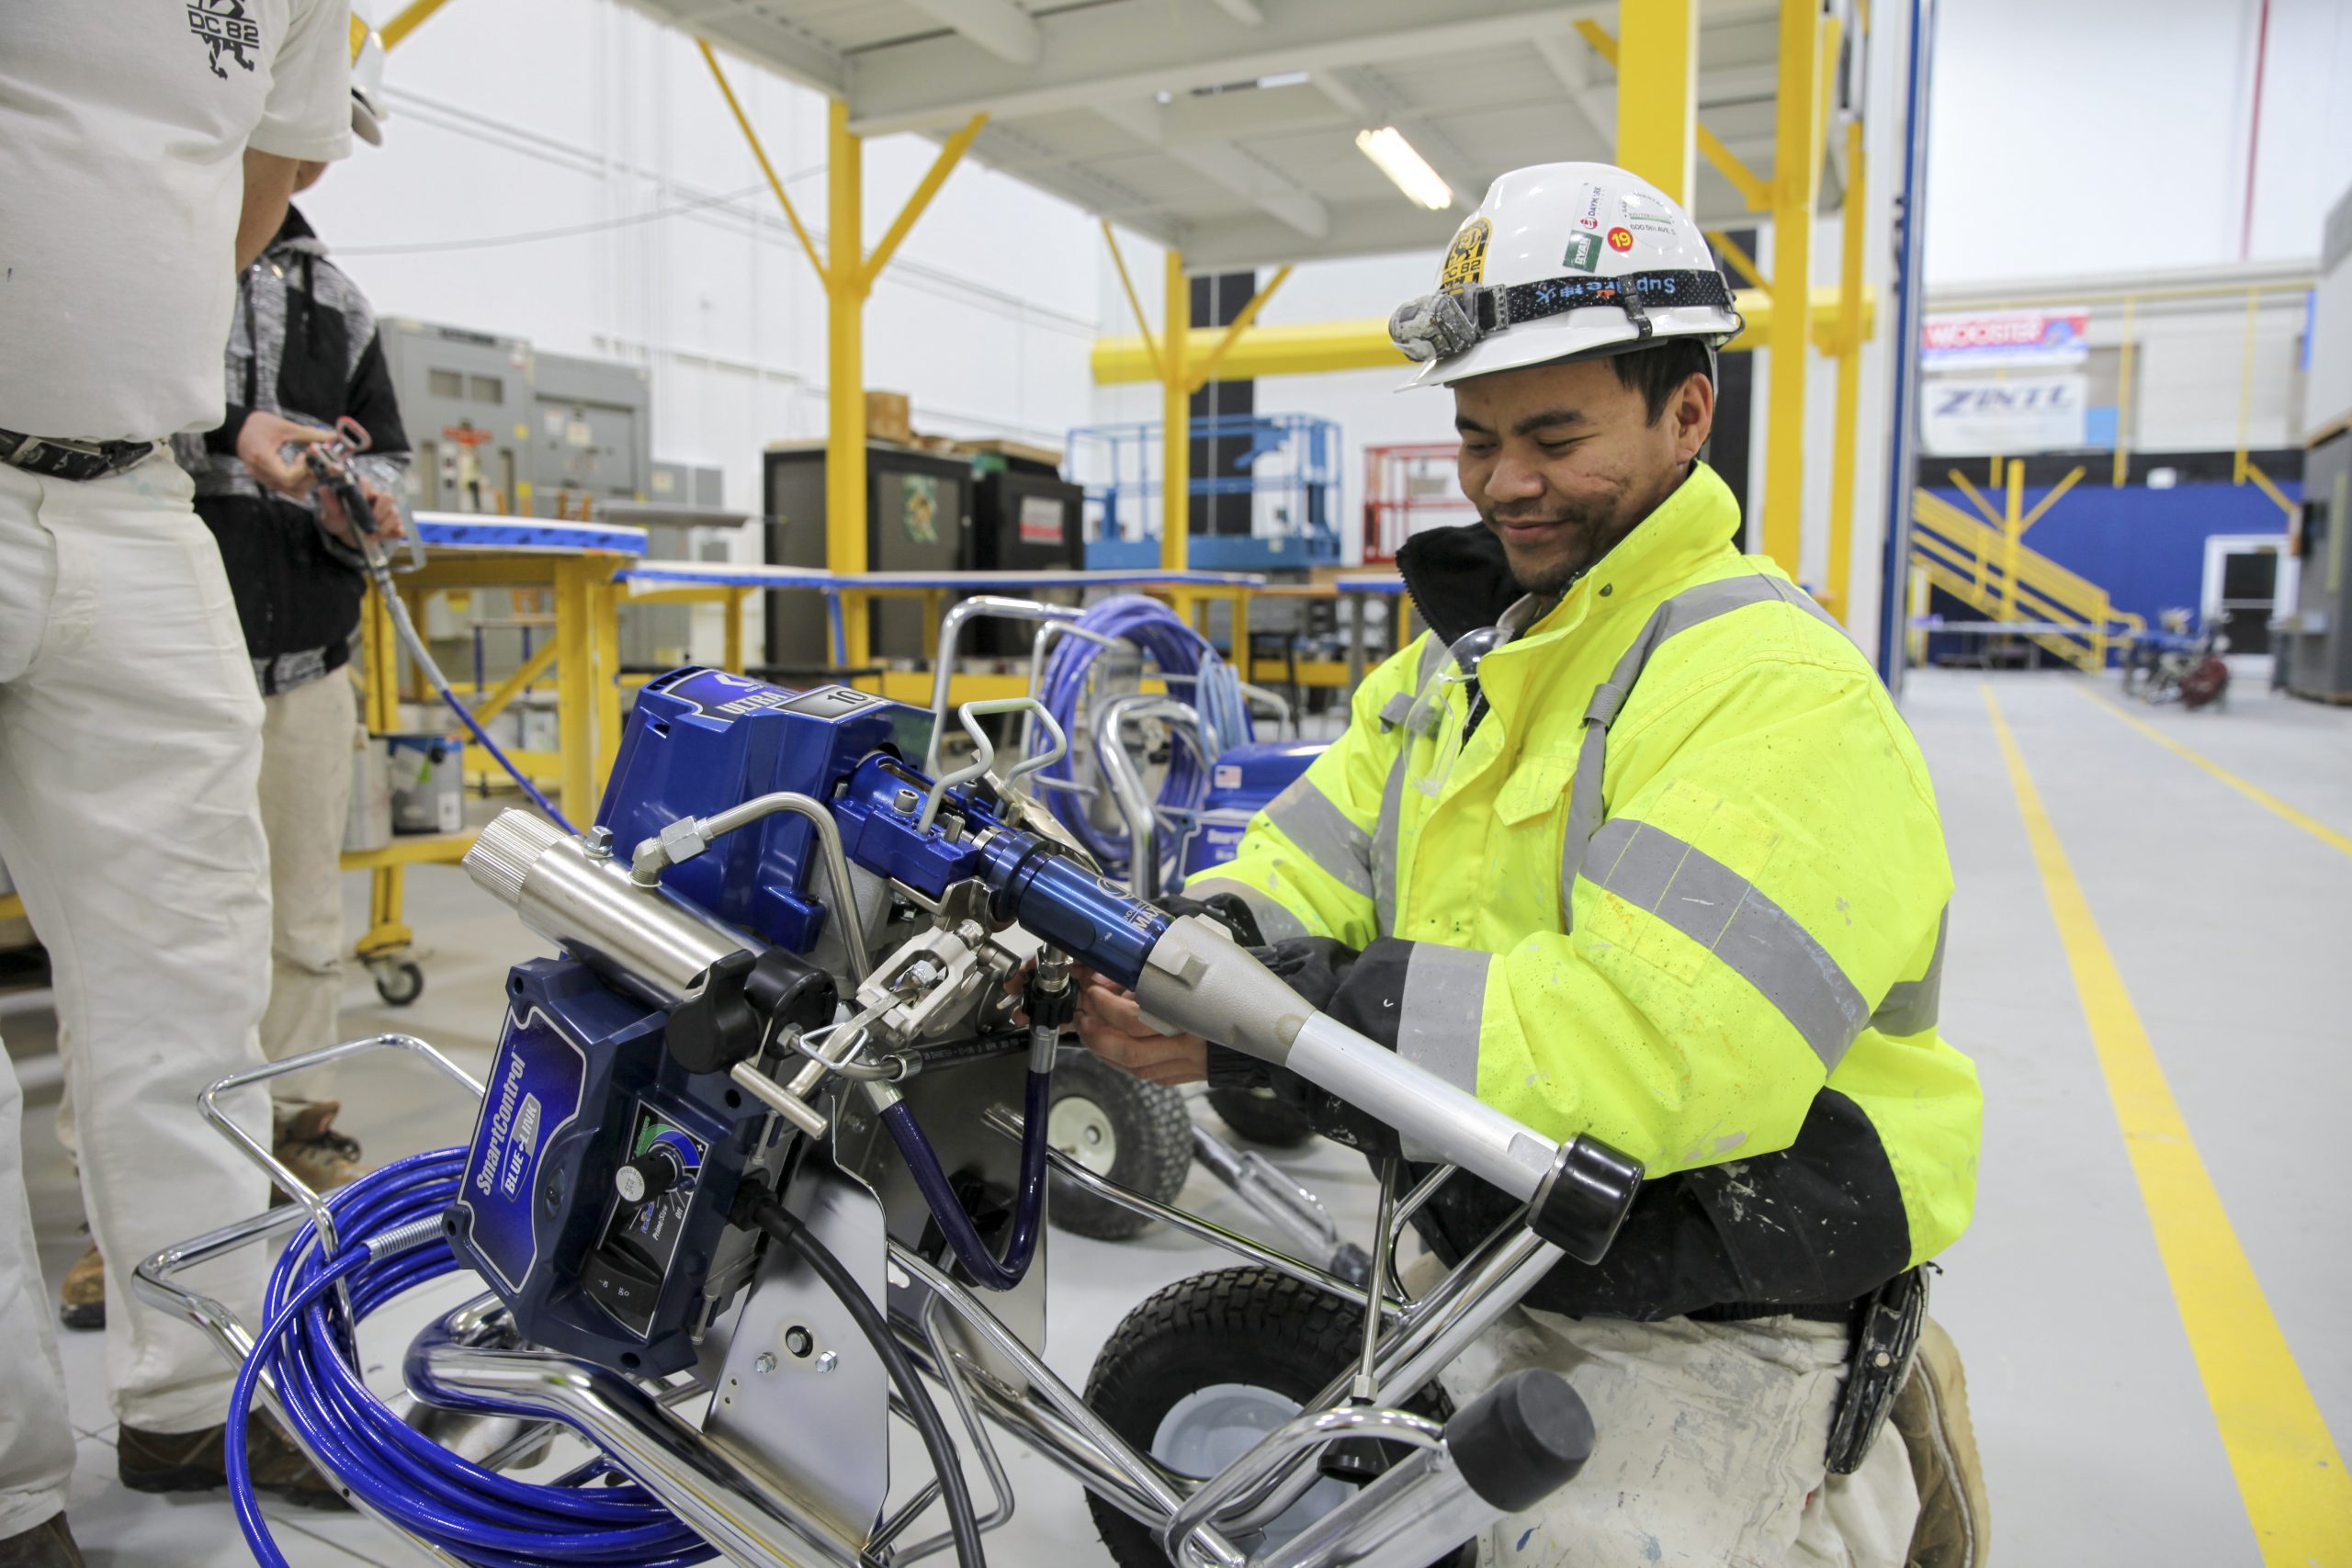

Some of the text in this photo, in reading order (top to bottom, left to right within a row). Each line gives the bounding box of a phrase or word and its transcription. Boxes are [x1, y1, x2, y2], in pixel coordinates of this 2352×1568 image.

[188, 10, 259, 43] DC 82
[1574, 237, 1590, 265] RYAN
[1611, 231, 1632, 247] 19
[1461, 259, 1481, 274] 82
[1934, 386, 2073, 416] ZINTL
[716, 691, 788, 714] ULTRA
[477, 1052, 526, 1195] SmartControl
[505, 1102, 537, 1194] BLUE LINK
[652, 1204, 668, 1240] Prime/Slow
